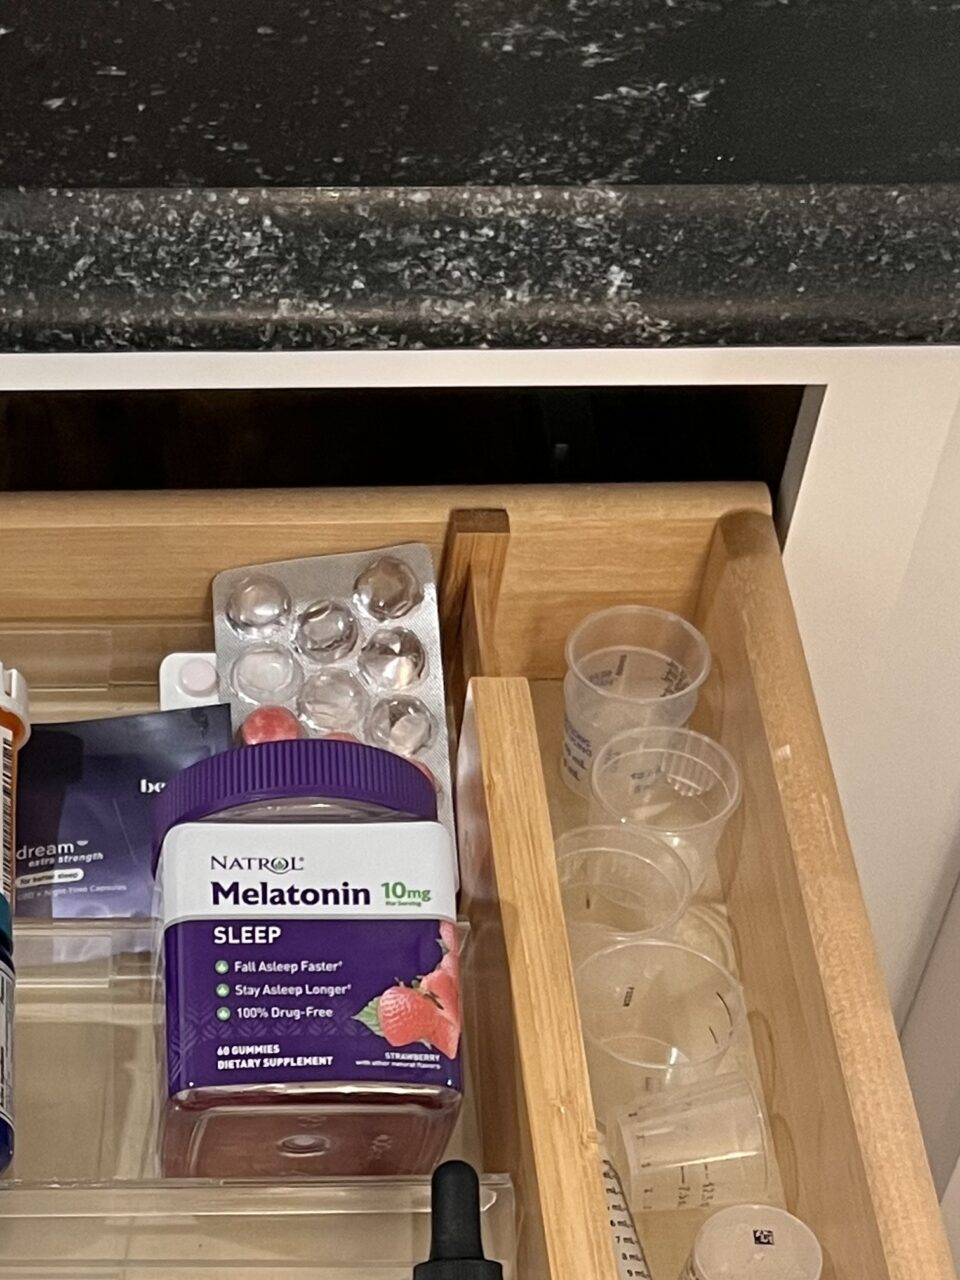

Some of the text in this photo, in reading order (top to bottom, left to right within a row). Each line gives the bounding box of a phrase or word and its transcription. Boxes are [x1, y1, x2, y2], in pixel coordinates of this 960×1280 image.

[17, 842, 74, 860] dream
[29, 852, 104, 867] extra strength
[210, 882, 432, 905] Melatonin 10mg
[214, 926, 281, 944] SLEEP
[234, 962, 256, 972] Fall
[258, 962, 298, 974] Asleep
[235, 984, 259, 996] Stay
[262, 984, 302, 998] Asleep
[236, 1008, 333, 1020] 100% Drug-Free
[217, 1044, 280, 1056] 60 GUMMIES
[218, 1056, 333, 1069] DIETARY SUPPLEMENT
[385, 1052, 440, 1062] STRAWBERRY
